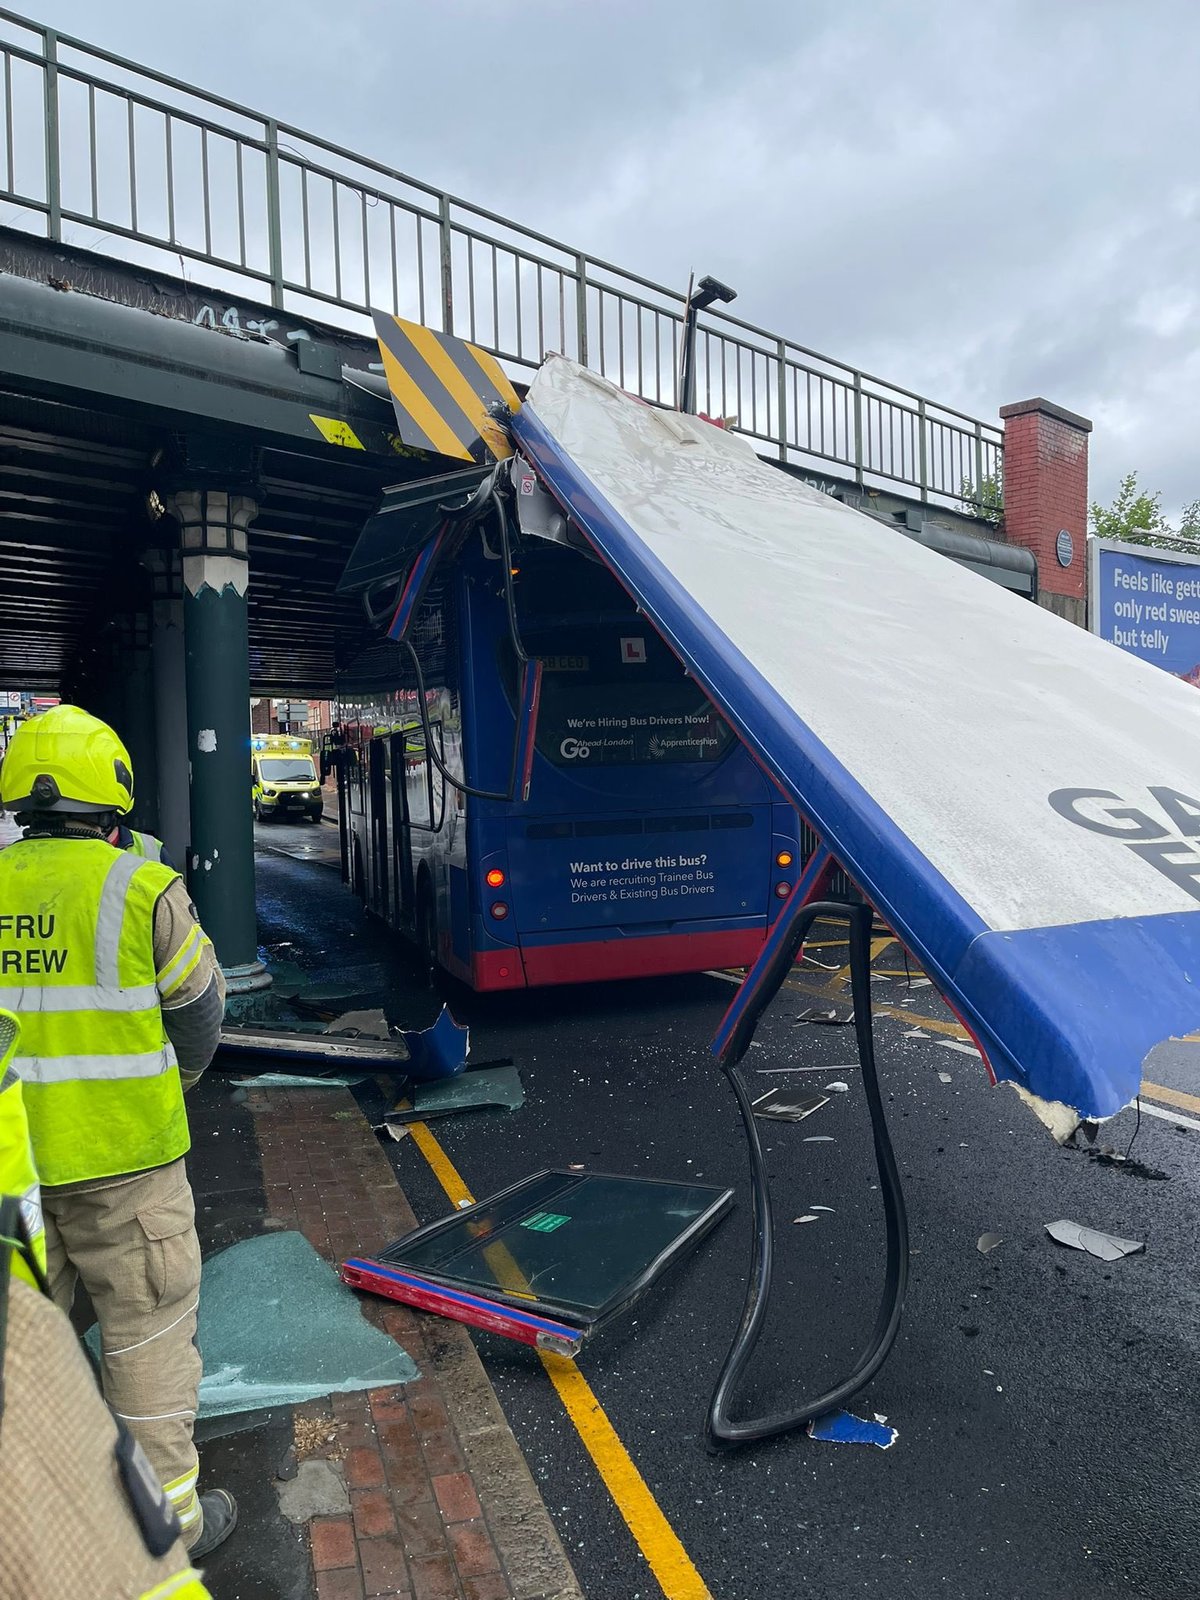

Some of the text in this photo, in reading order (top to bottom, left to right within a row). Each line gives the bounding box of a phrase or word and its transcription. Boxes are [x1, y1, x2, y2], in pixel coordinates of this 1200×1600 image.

[1113, 567, 1200, 601] Feels like gett
[1113, 599, 1200, 625] only red swee
[626, 642, 640, 658] L
[1140, 629, 1169, 655] telly
[567, 714, 710, 729] We're Hiring Bus Drivers Now!
[560, 737, 634, 759] Go Ahead London
[660, 737, 718, 748] Apprenticeships
[569, 854, 707, 874] Want to drive this bus?
[1122, 840, 1200, 903] E
[570, 869, 714, 889] We are recruiting Trainee Bus
[571, 884, 715, 903] Drivers & Existing Bus Drivers
[0, 914, 55, 939] FRU
[2, 949, 68, 974] REW
